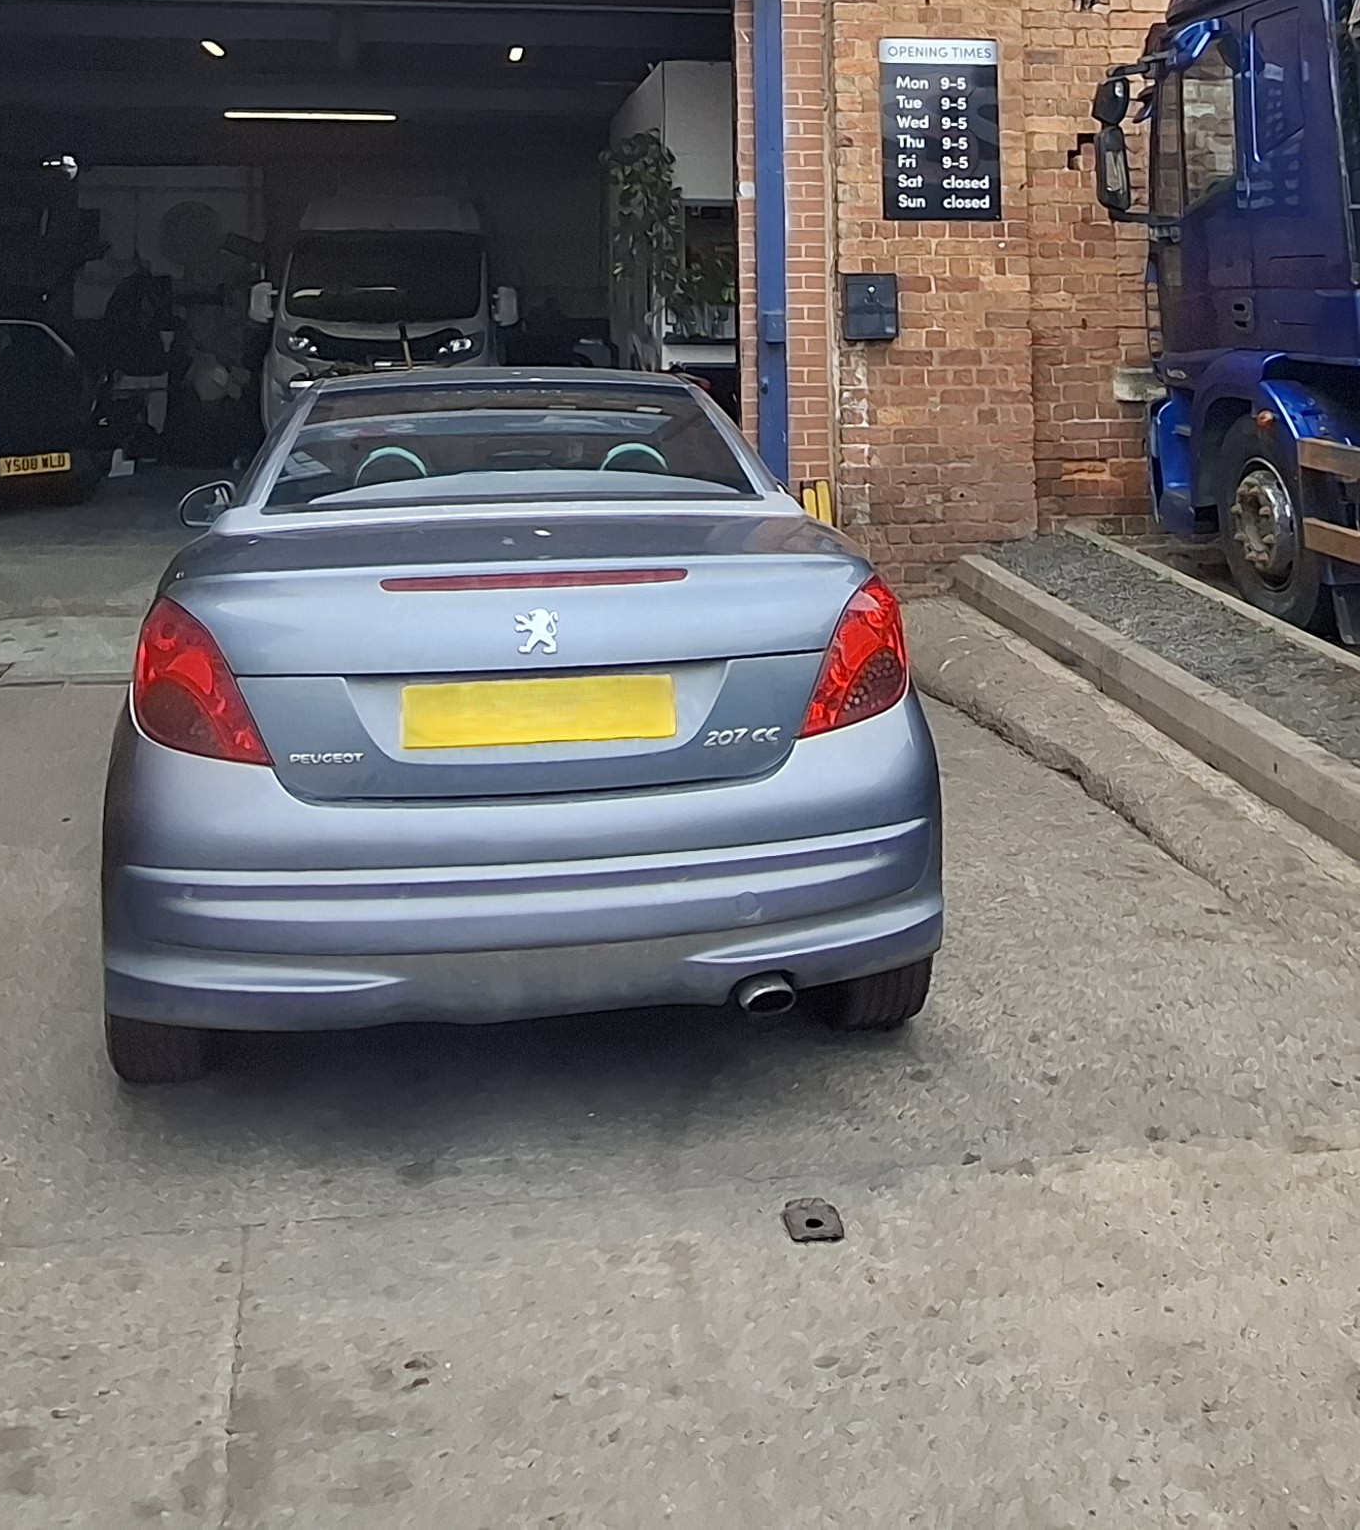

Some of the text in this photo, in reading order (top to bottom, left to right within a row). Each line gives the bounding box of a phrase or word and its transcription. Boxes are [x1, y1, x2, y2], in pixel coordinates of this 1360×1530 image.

[887, 45, 992, 59] OPENING TIMES
[896, 76, 967, 90] Mon 9-5
[896, 95, 967, 110] Tue 9-5
[896, 115, 968, 130] Wed 9-5
[896, 135, 968, 150] Thu 9-5
[897, 154, 969, 169] Fri 9-5
[897, 174, 990, 189] Sat closed
[898, 194, 991, 209] Sun closed
[703, 726, 781, 747] 207 CC
[289, 752, 364, 764] PEUGEOT
